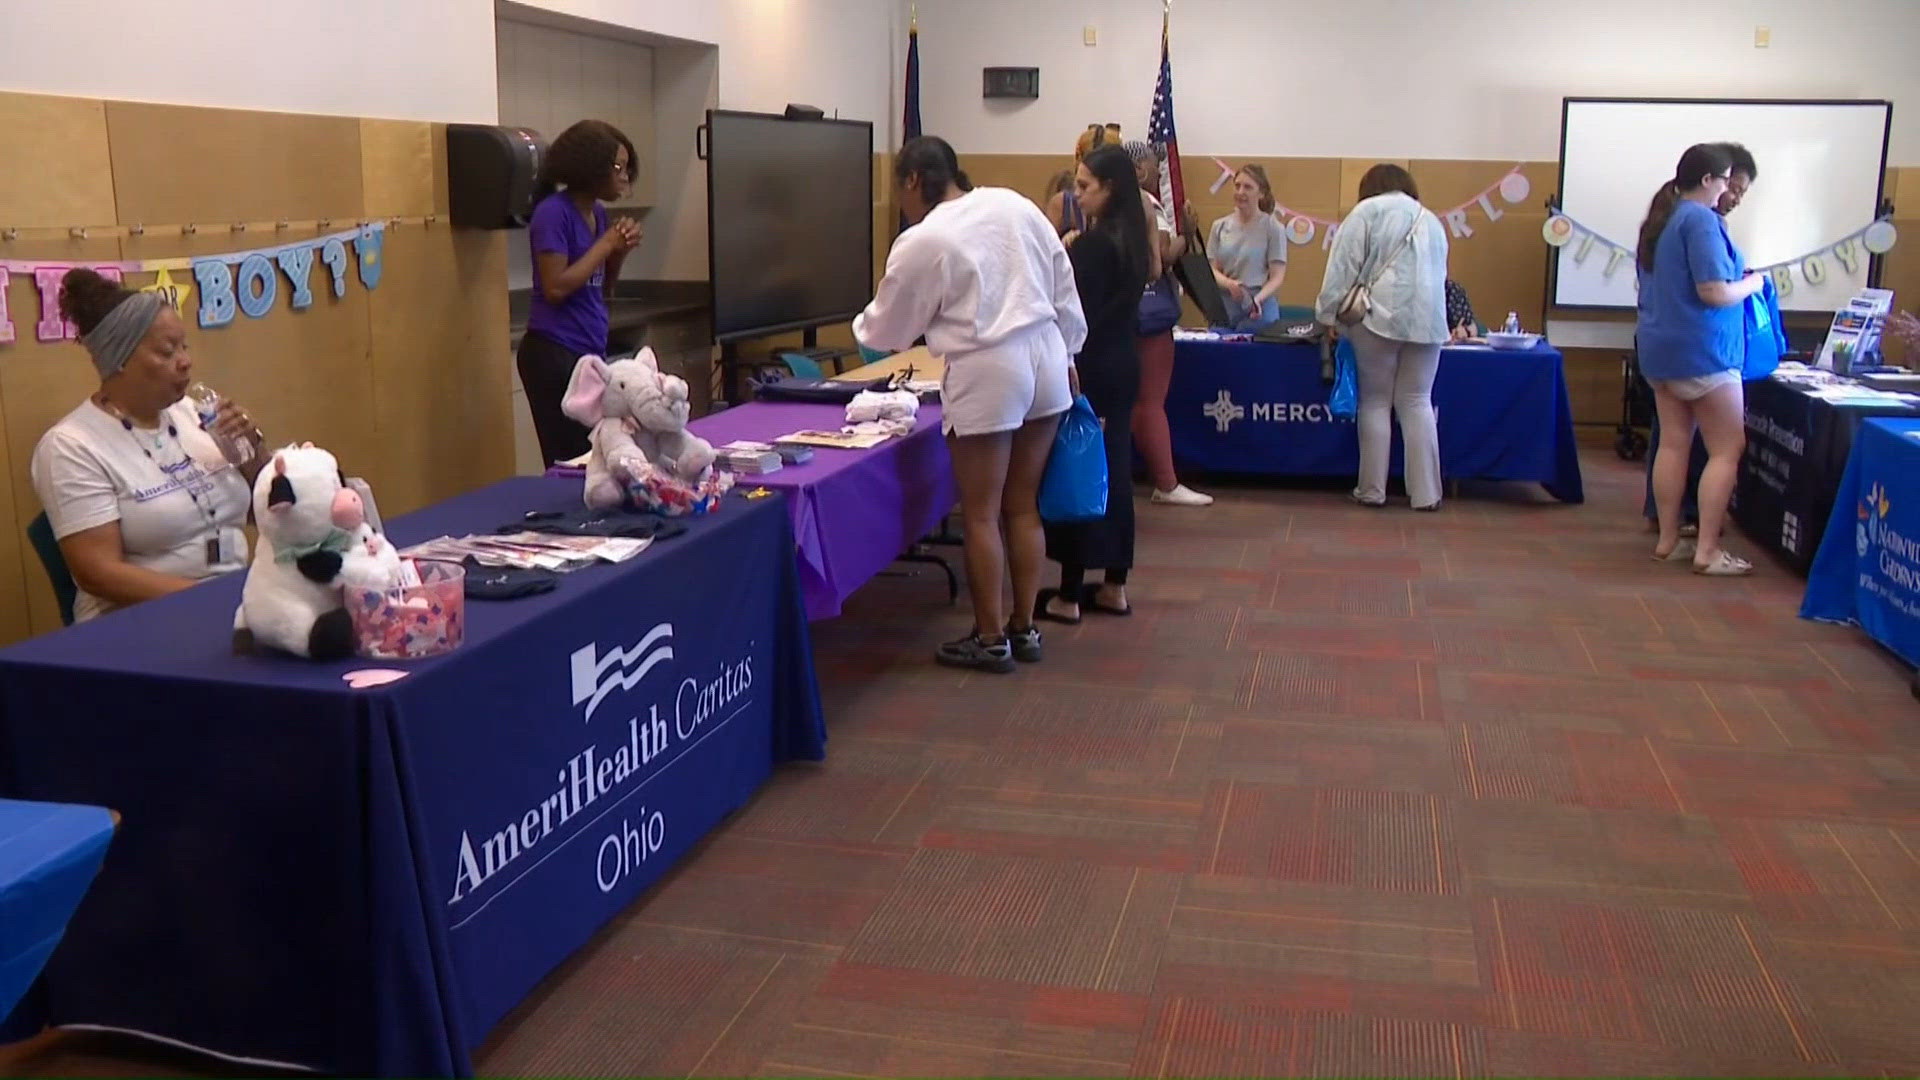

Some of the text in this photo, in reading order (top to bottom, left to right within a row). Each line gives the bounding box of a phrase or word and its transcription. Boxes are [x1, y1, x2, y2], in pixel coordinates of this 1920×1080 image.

[192, 237, 348, 329] BOY?
[1770, 240, 1860, 298] BOY
[1252, 402, 1334, 423] MERCY
[448, 654, 753, 905] AmeriHealth Caritas
[596, 804, 665, 893] Ohio
